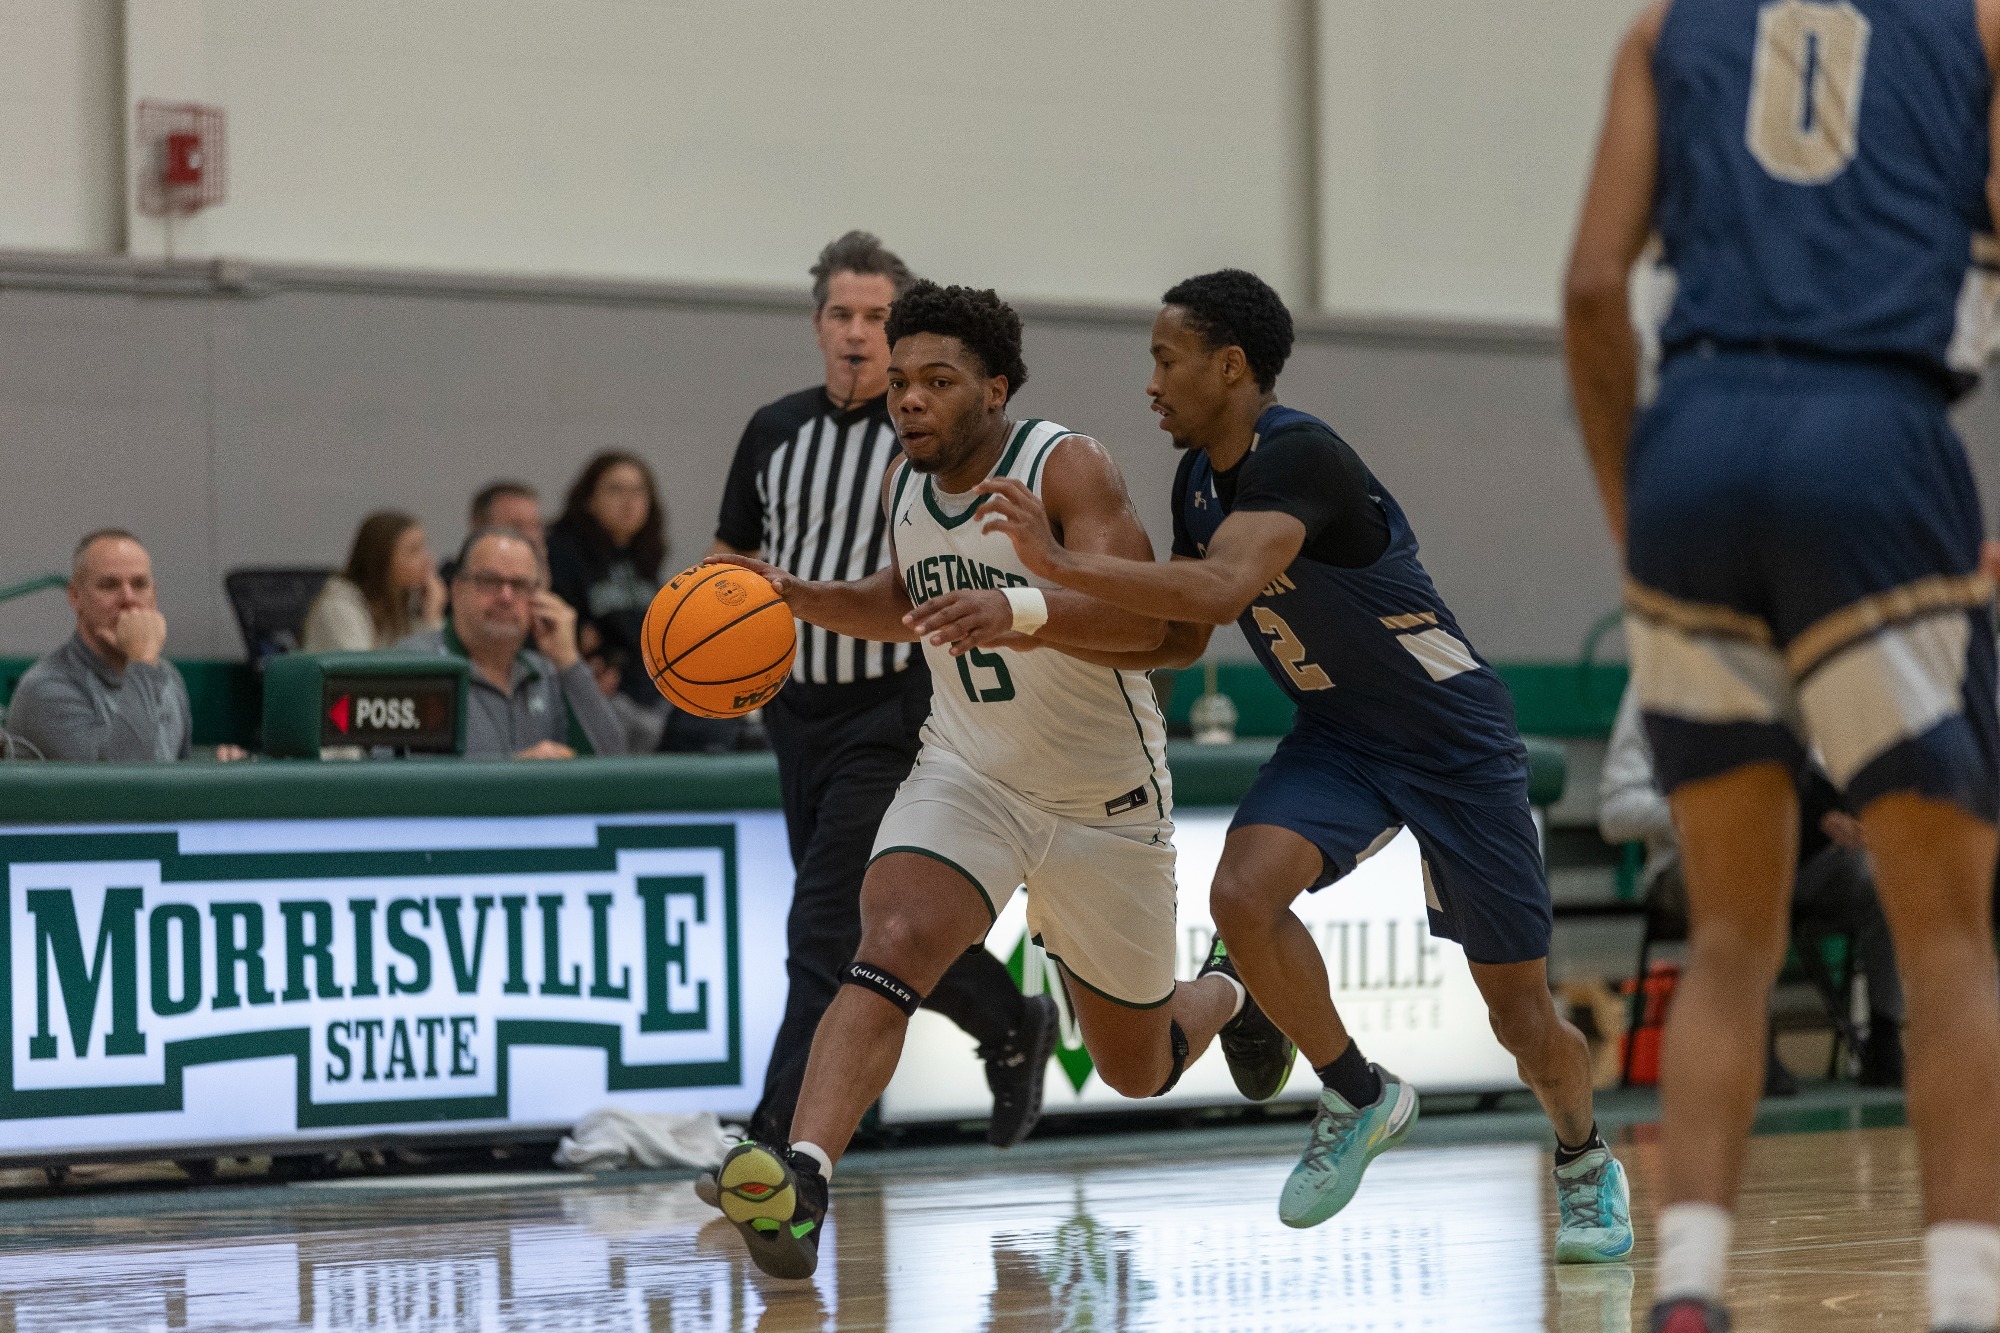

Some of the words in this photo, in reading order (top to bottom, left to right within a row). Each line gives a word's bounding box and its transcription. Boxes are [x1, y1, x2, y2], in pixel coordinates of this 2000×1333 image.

[1746, 1, 1871, 186] 0
[1252, 606, 1336, 691] 2
[355, 697, 421, 729] POSS.
[27, 875, 708, 1060] MORRISVILLE
[857, 968, 911, 1002] MUELLER
[326, 1015, 478, 1084] STATE
